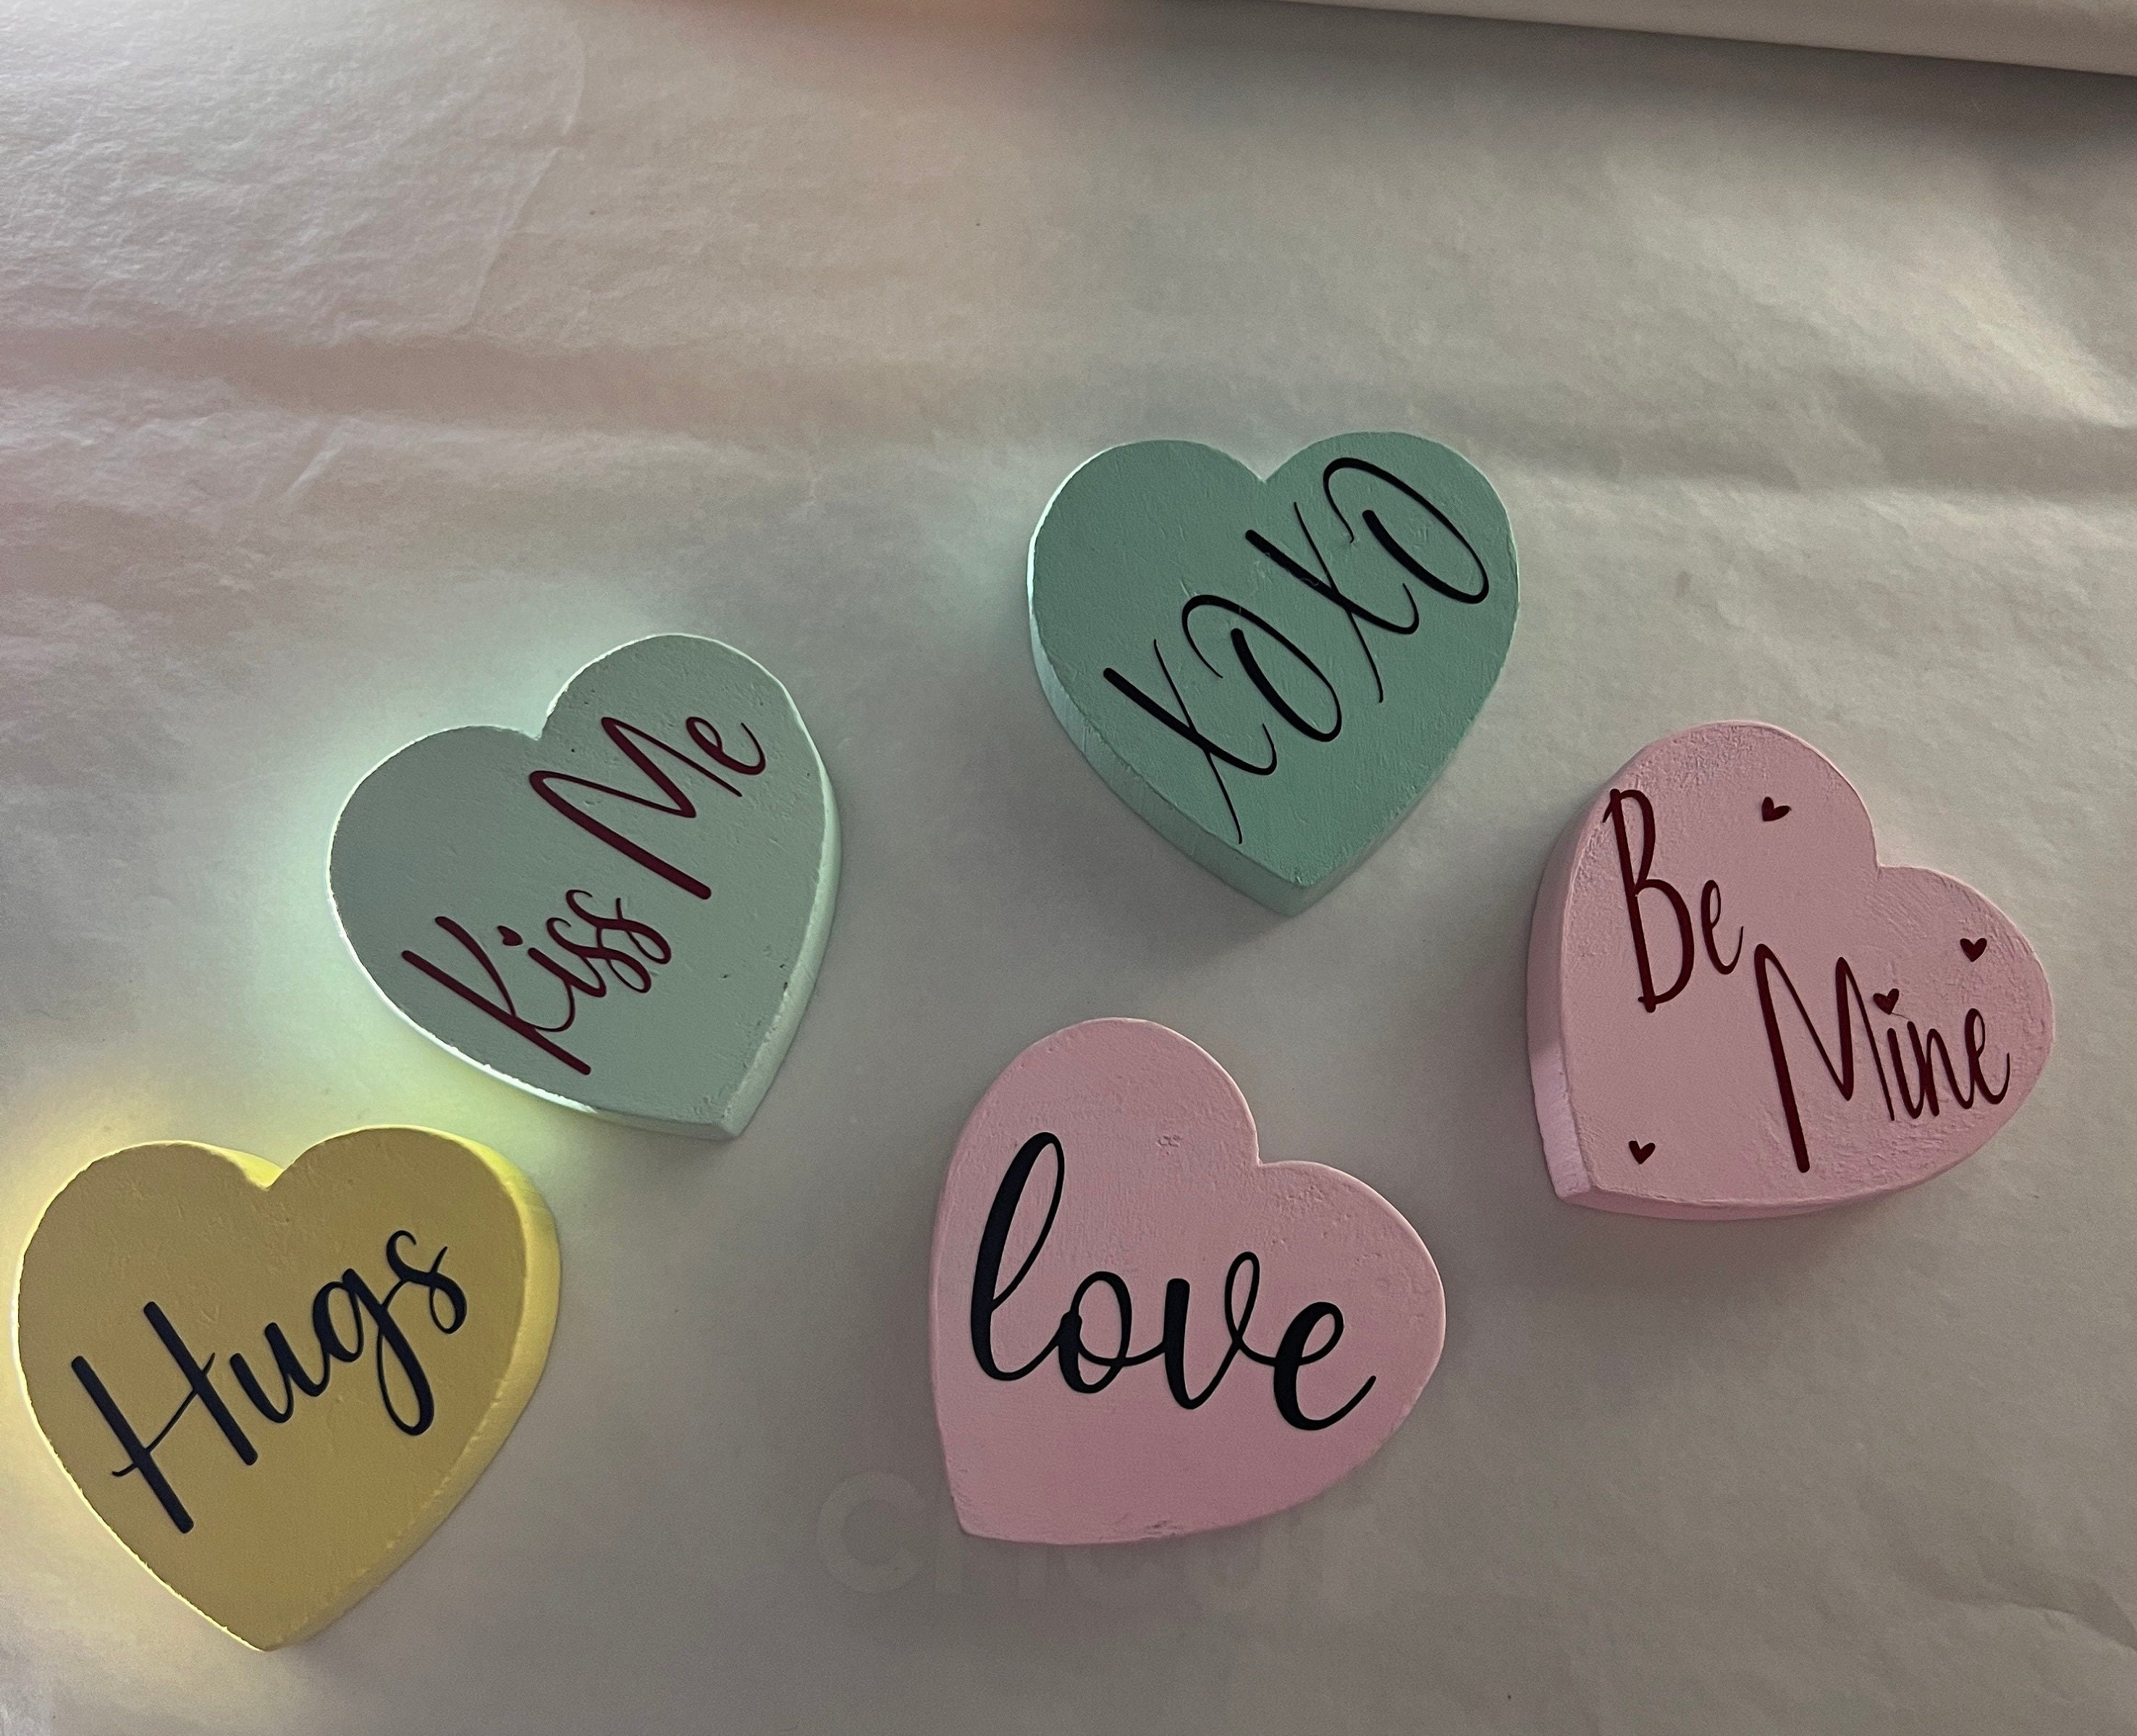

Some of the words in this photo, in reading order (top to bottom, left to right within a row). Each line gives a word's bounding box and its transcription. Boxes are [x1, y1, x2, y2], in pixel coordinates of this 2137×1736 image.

[1103, 457, 1490, 845] XOXO
[528, 716, 767, 900] Me
[1602, 788, 1744, 1014] Be
[401, 889, 672, 1076] Kiss
[1753, 943, 2010, 1174] Mine
[71, 1230, 468, 1534] Hugs
[970, 1132, 1377, 1431] love
